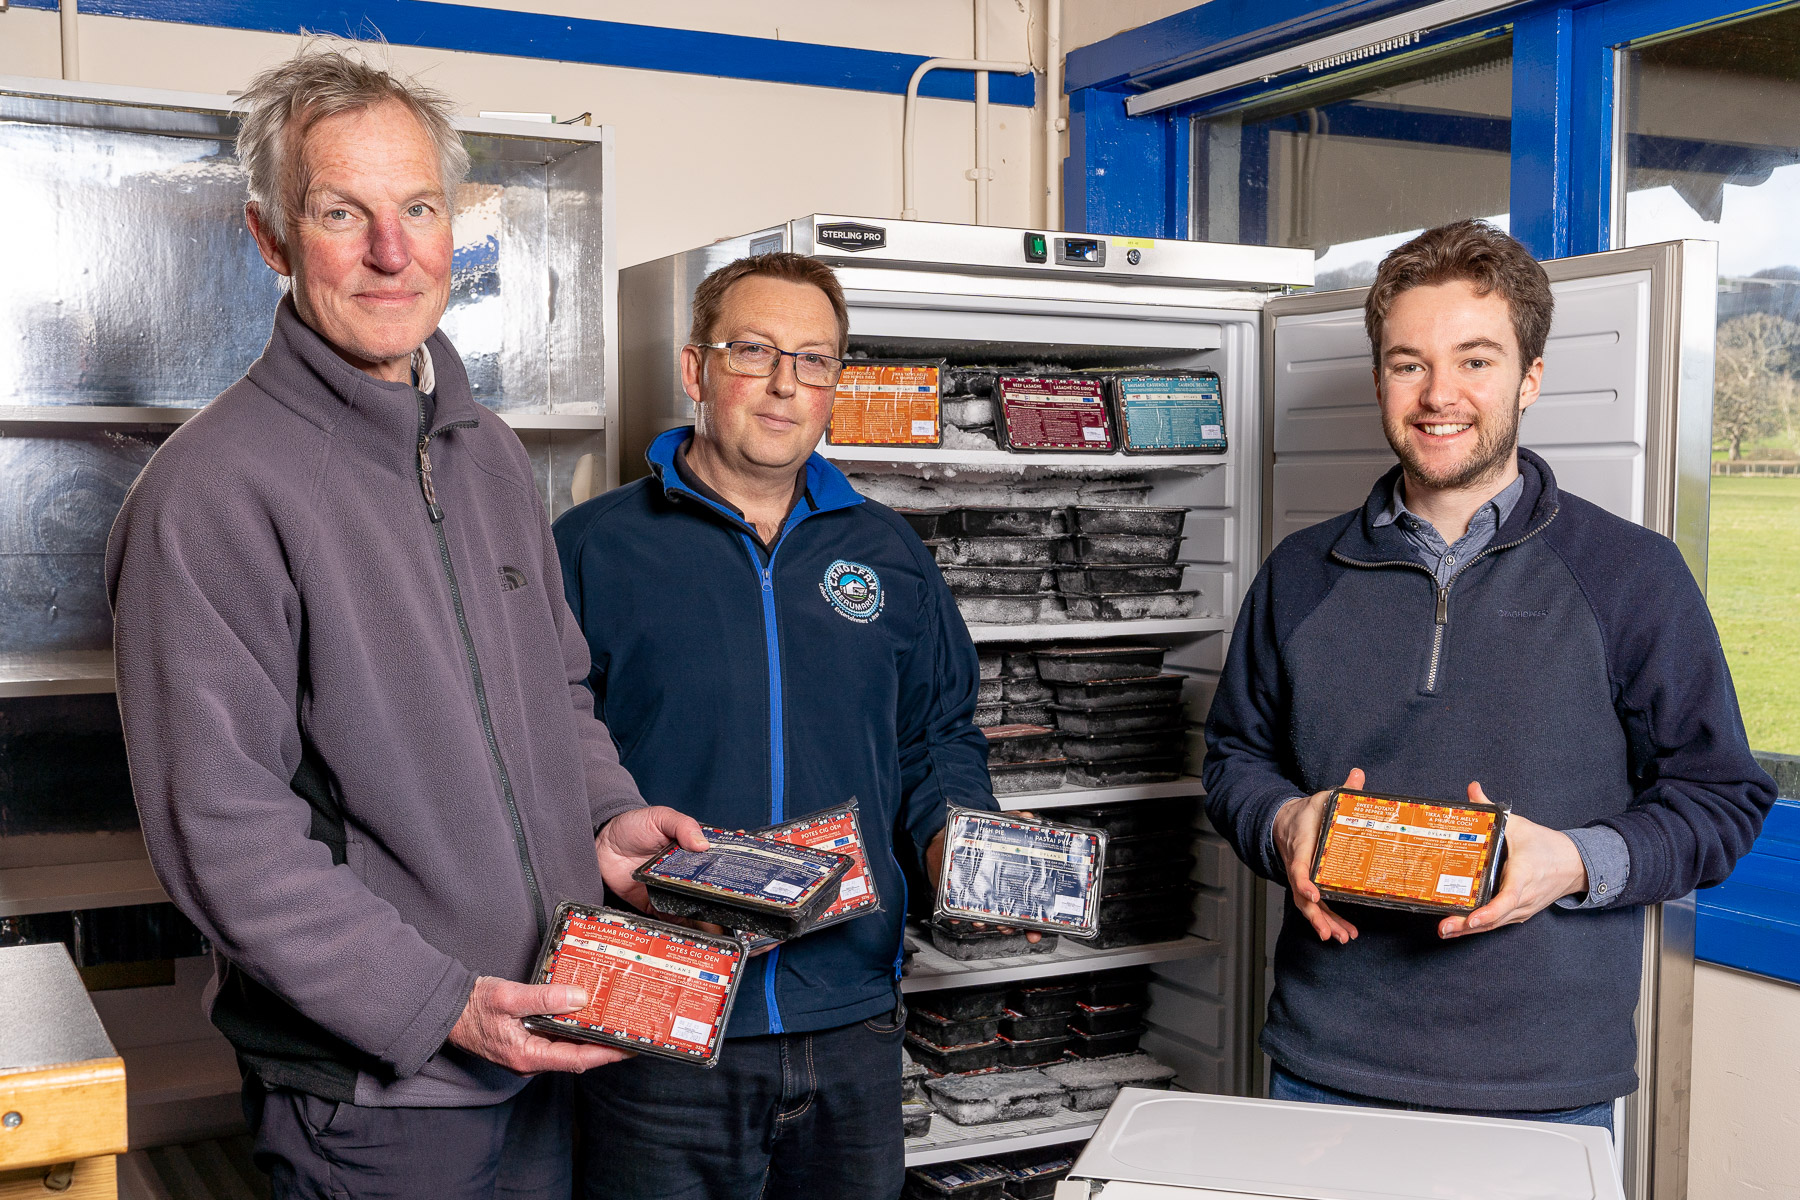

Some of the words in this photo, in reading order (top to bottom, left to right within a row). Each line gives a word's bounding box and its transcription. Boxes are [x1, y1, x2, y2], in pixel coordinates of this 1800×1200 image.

[822, 230, 862, 240] STERLING
[863, 232, 881, 241] PRO
[830, 565, 877, 590] CANOLFAN
[833, 590, 875, 611] BEAUMARIS
[801, 830, 818, 839] POTES
[819, 827, 829, 835] CIG
[573, 920, 596, 931] WELSH
[597, 925, 617, 936] LAMB
[618, 931, 634, 940] HOT
[635, 936, 650, 945] POT
[665, 944, 688, 955] POTES
[689, 950, 702, 959] CIG
[704, 954, 720, 963] OEN
[665, 963, 691, 974] DYLAN'S
